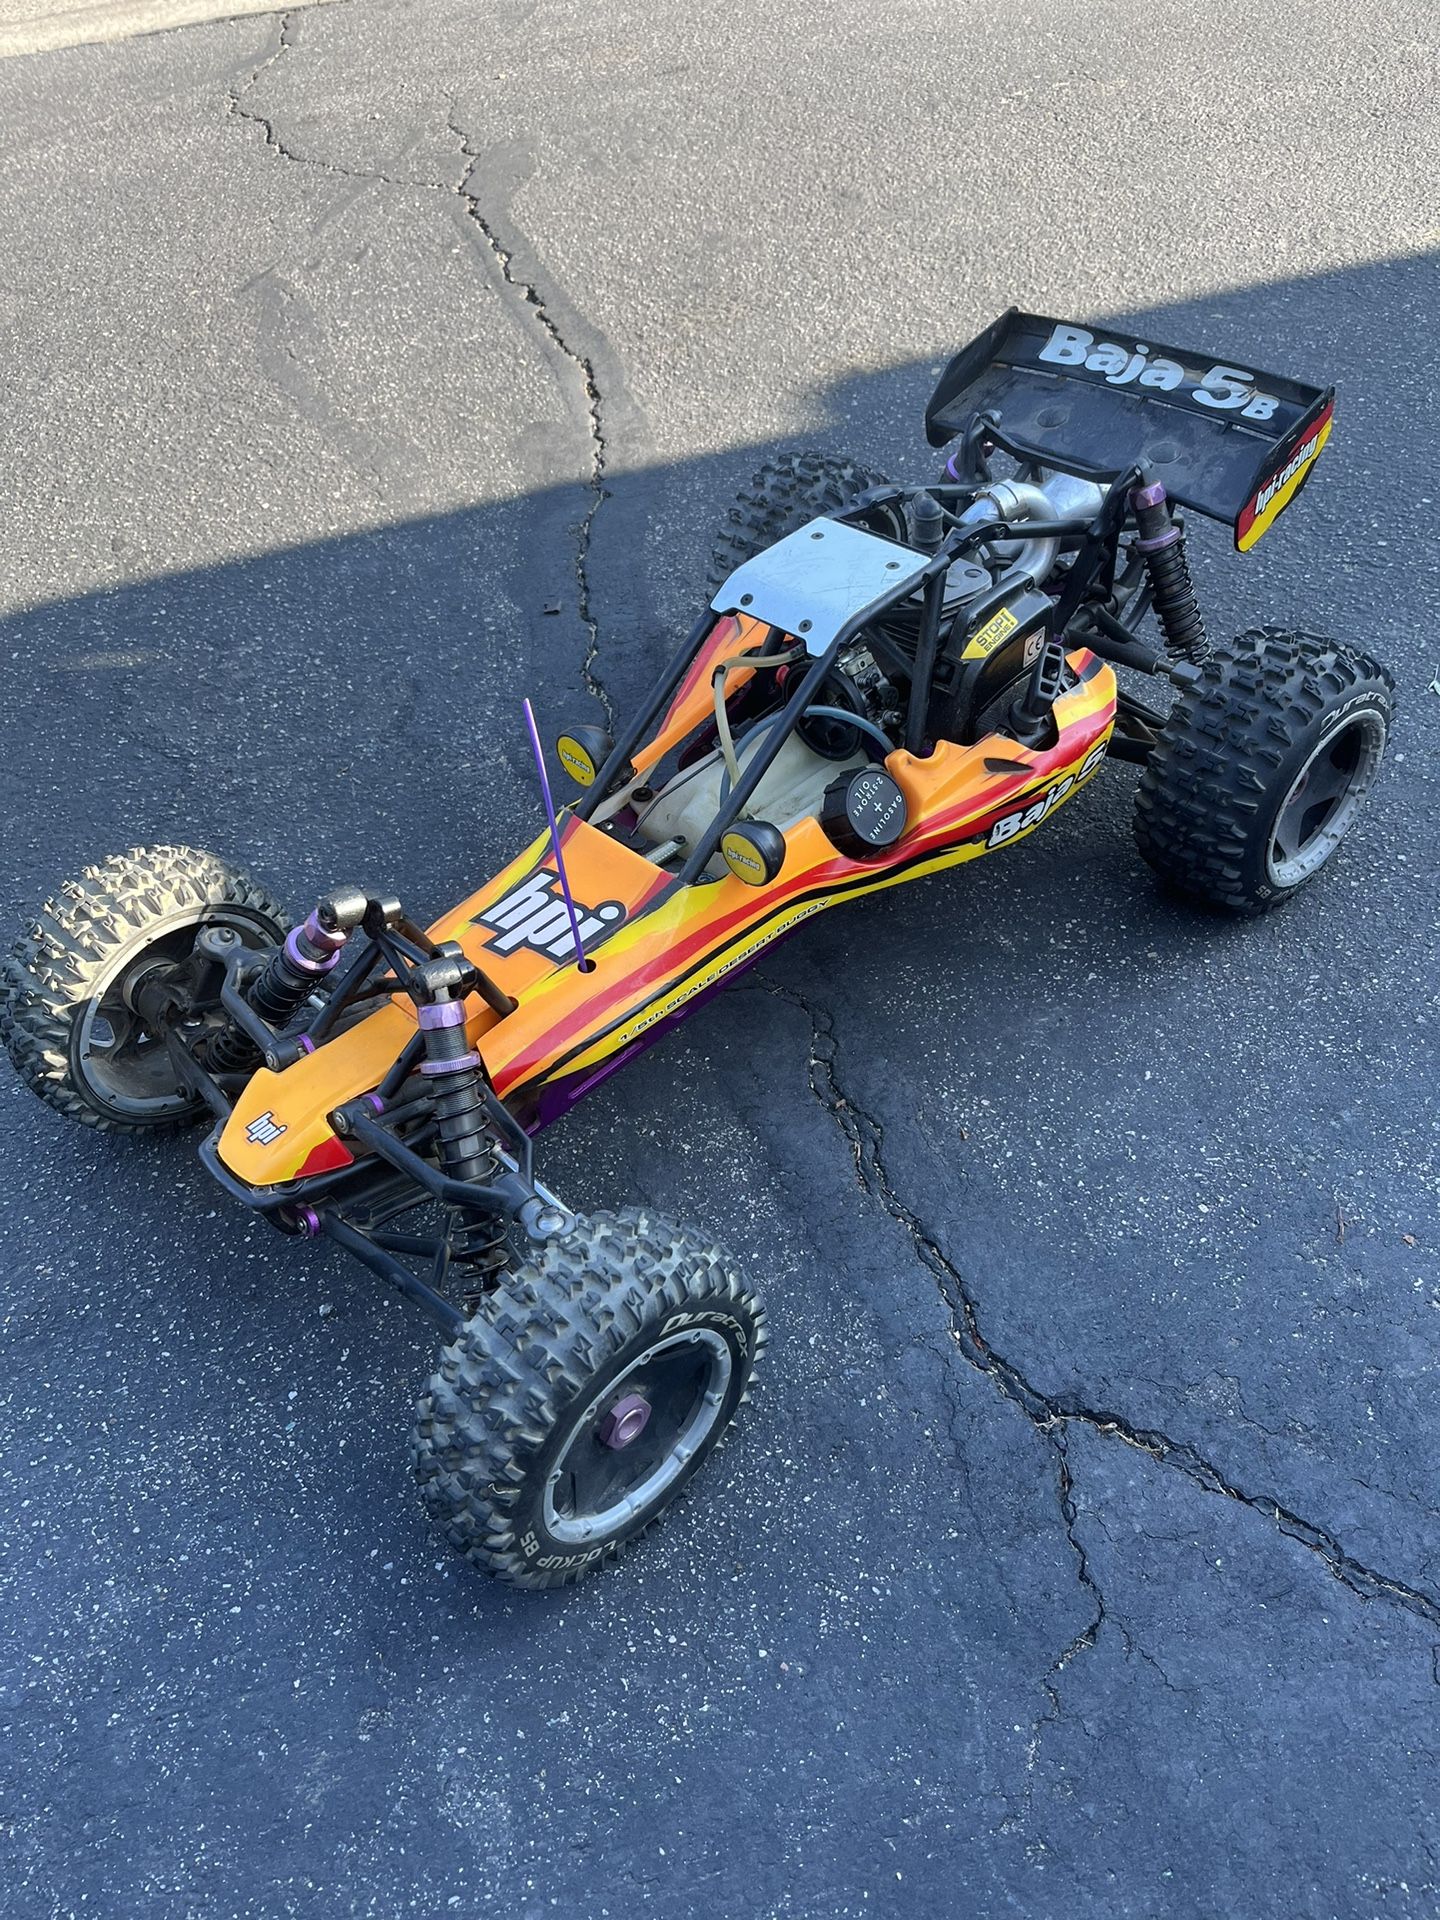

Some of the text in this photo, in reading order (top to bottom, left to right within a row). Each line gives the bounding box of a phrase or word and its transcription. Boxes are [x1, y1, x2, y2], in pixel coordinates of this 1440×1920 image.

[244, 110, 288, 146] hpi
[1038, 323, 1185, 391] Baja
[854, 781, 870, 799] OIL
[986, 775, 1076, 848] Baja
[869, 795, 903, 840] GASOLINE
[477, 871, 621, 959] hpi
[665, 973, 717, 1012] SCALE
[718, 931, 774, 975] DESERT
[776, 898, 832, 935] BUGGY
[658, 1311, 748, 1358] Duratrax
[536, 1540, 617, 1570] LOCKUP
